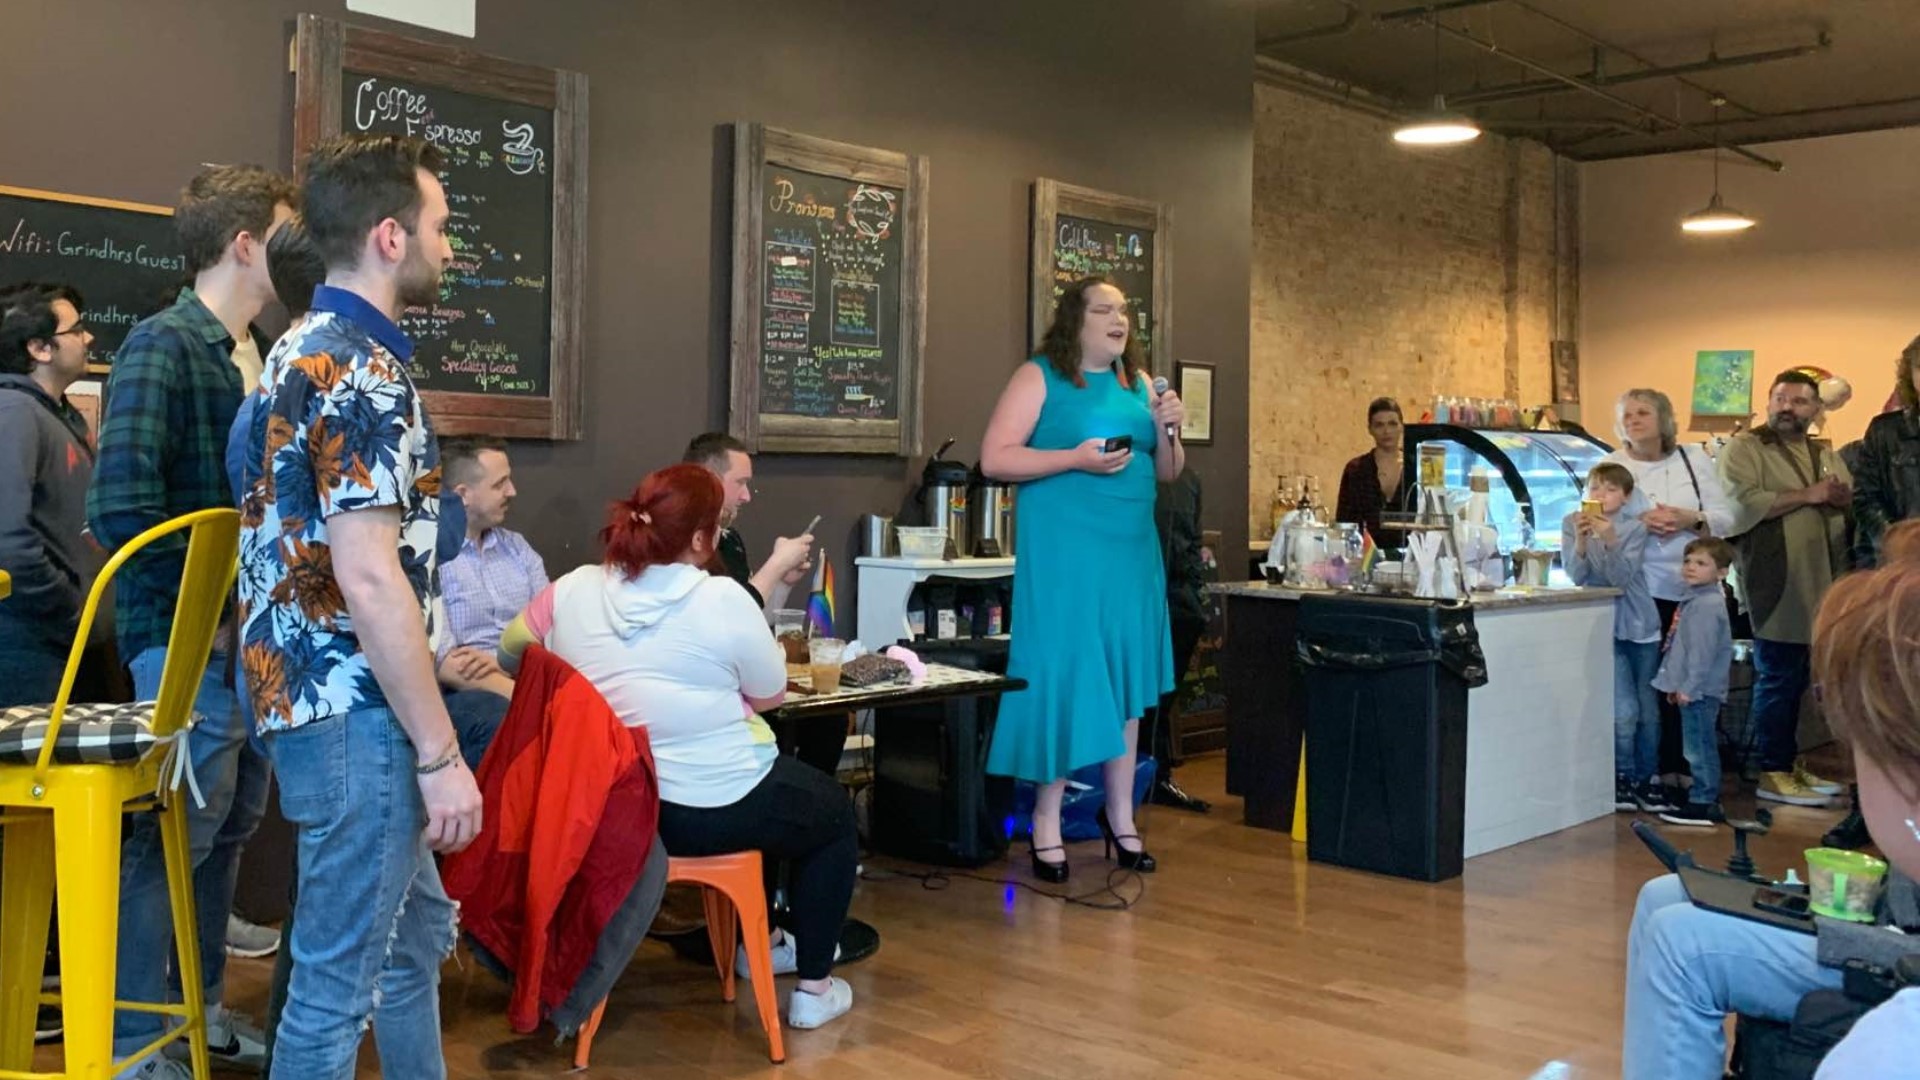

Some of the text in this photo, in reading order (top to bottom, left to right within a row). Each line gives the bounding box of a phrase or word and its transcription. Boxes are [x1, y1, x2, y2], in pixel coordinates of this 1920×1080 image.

[355, 78, 428, 130] Coffee
[405, 117, 482, 146] Espresso
[80, 304, 139, 328] rindhrs
